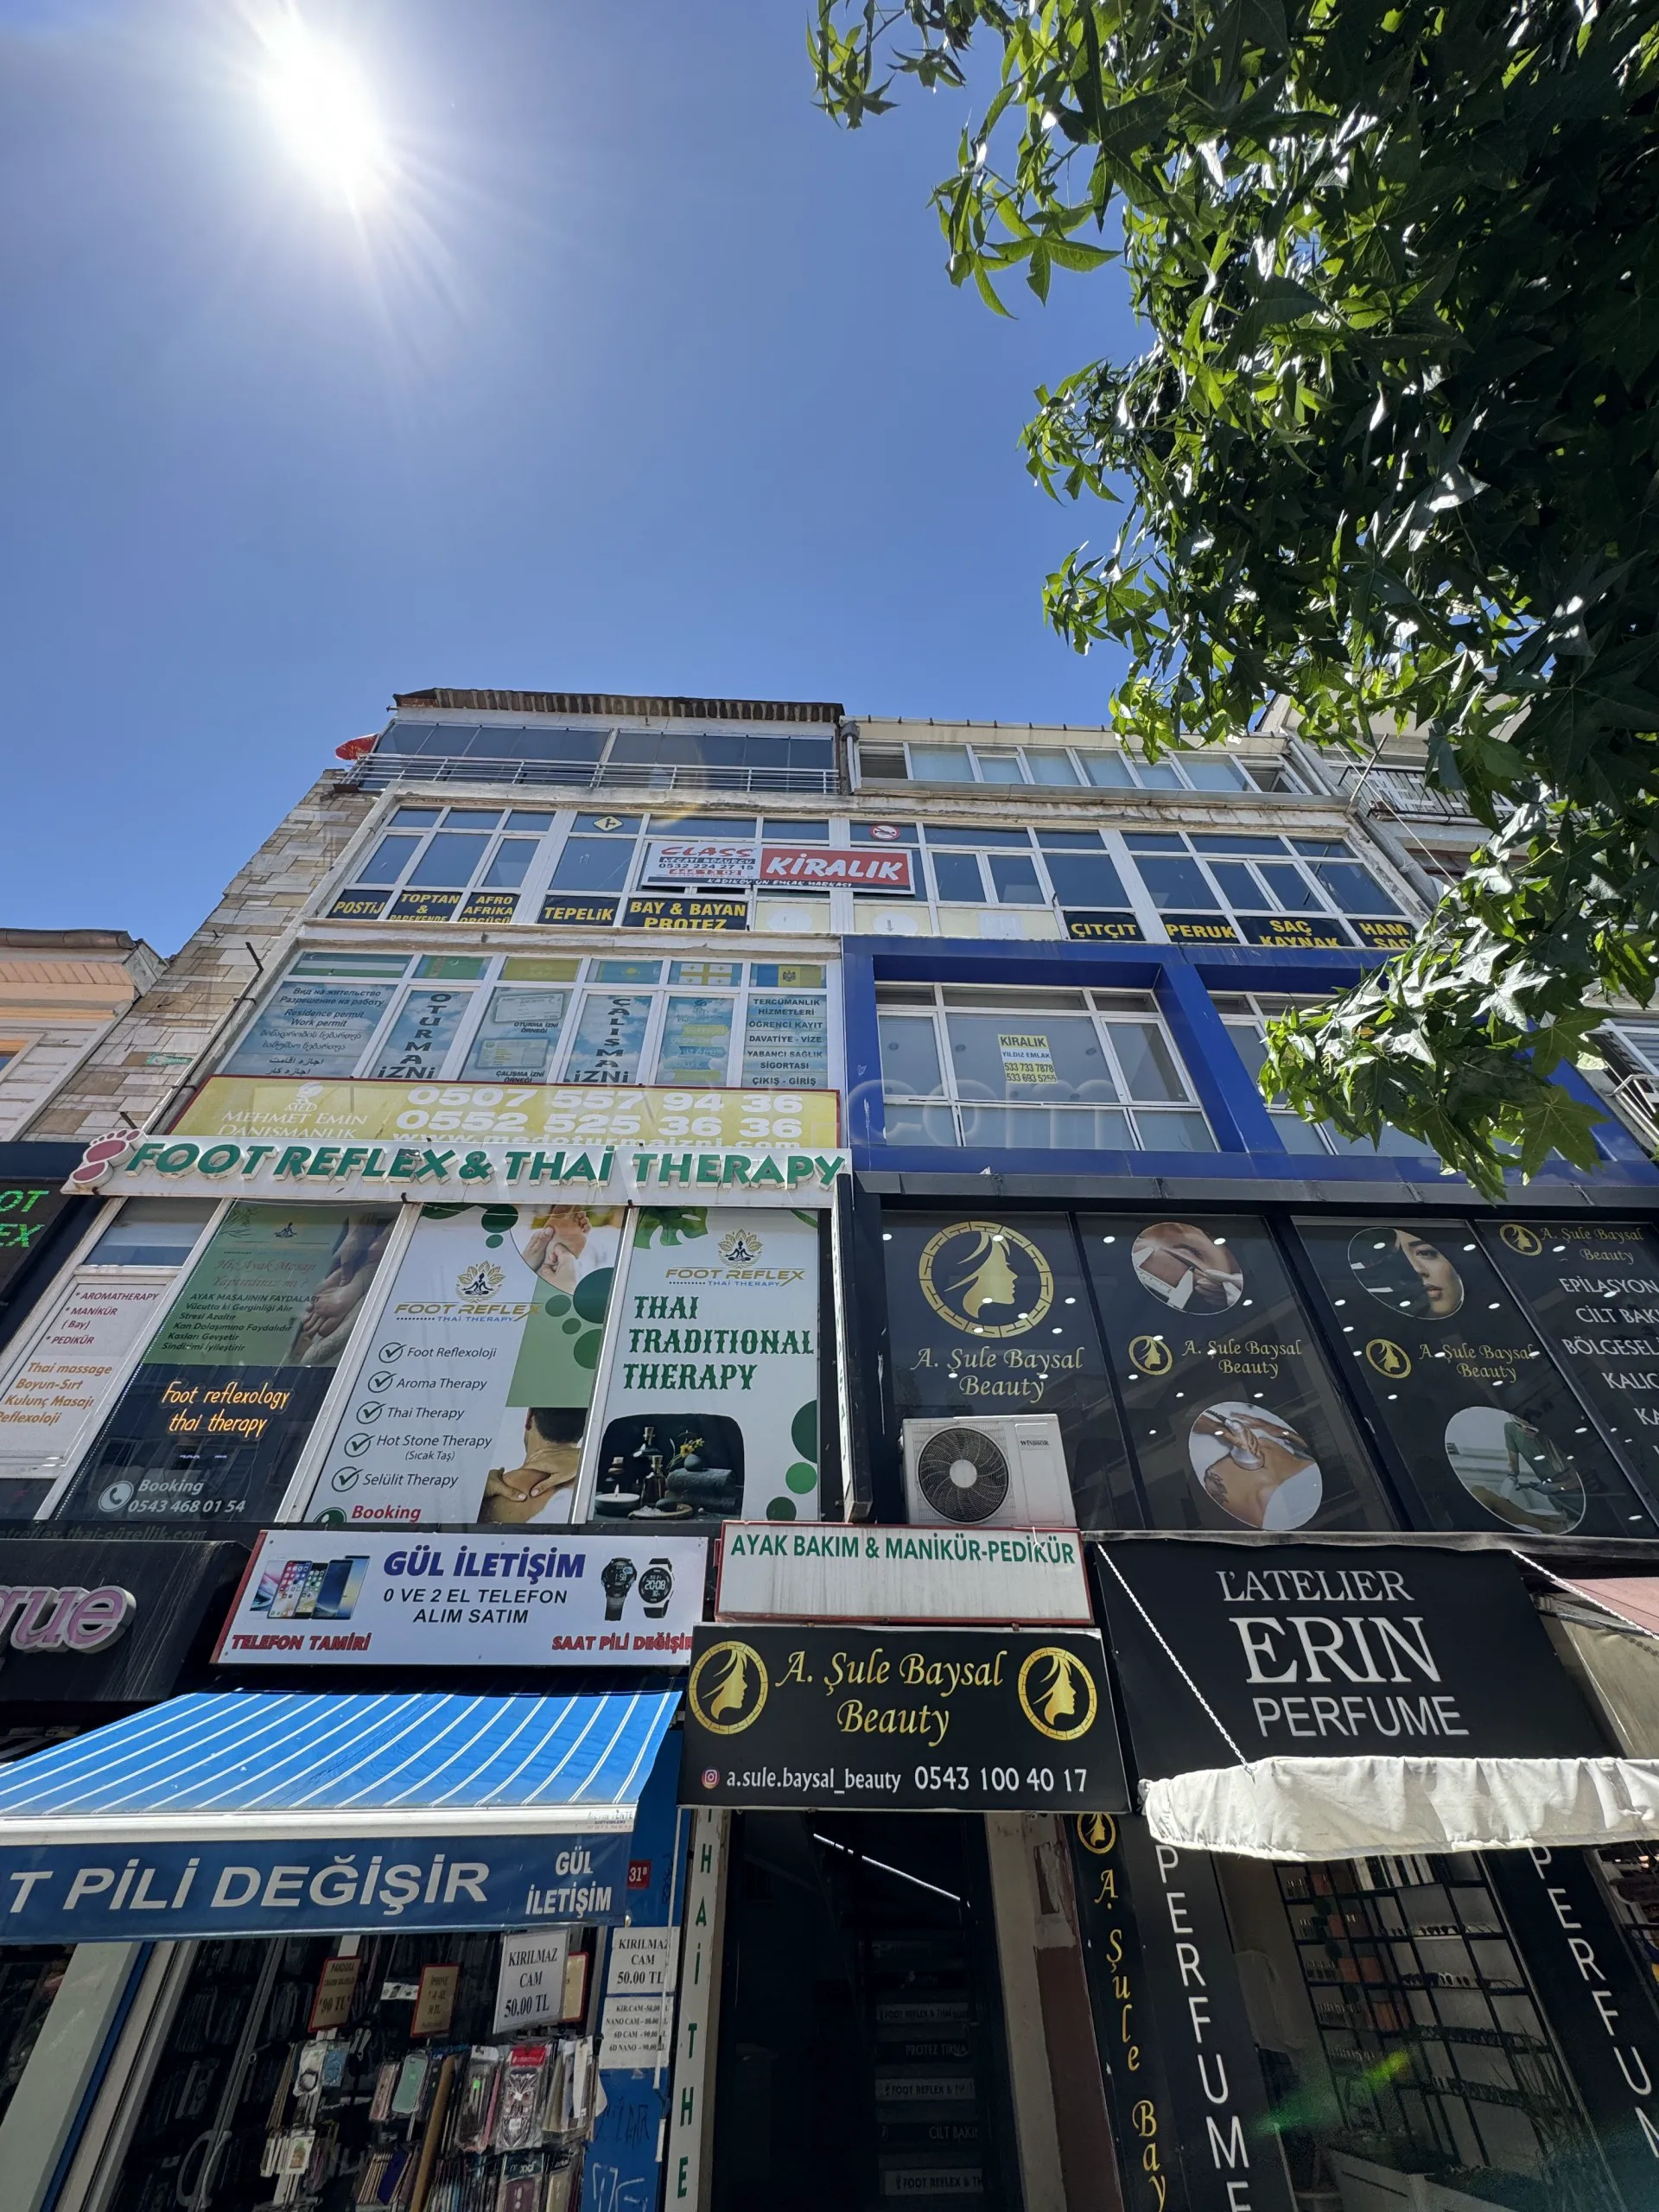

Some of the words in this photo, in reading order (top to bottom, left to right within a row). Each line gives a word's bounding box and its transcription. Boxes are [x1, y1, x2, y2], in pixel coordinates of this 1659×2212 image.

[766, 853, 903, 880] KİRALIK
[401, 893, 460, 904] TOPTAN
[476, 896, 512, 905] AFRO
[630, 901, 664, 914] BAY
[670, 903, 683, 915] &
[690, 904, 746, 917] BAYAN
[645, 917, 728, 930] PROTEZ
[1071, 923, 1136, 939] ÇITÇIT
[1166, 925, 1237, 938] PERUK
[1269, 919, 1313, 936] SAÇ
[1358, 922, 1408, 936] HAM
[1259, 935, 1340, 947] KAYNAK
[753, 997, 820, 1007] TERCÜMANLIK
[284, 1008, 332, 1017] Residence
[334, 1010, 365, 1020] permit
[758, 1007, 815, 1016] HİZMETLERİ
[315, 1020, 347, 1028] permit
[748, 1019, 792, 1029] ÖĞRENCİ
[749, 1033, 793, 1043] DAVATİYE
[800, 1034, 822, 1044] VİZE
[999, 1035, 1047, 1048] KİRALIK
[747, 1050, 787, 1058] YABANCI
[789, 1048, 823, 1058] SAĞLIK
[760, 1059, 810, 1070] SİGORTASI
[1004, 1062, 1019, 1072] 533
[1020, 1062, 1034, 1072] 733
[1036, 1063, 1054, 1073] 7878
[752, 1077, 779, 1087] ÇIKIŞ
[788, 1075, 817, 1087] GİRİŞ
[407, 1086, 537, 1108] 0507
[550, 1090, 644, 1109] 557
[663, 1092, 723, 1111] 94
[741, 1094, 803, 1113] 36
[220, 1110, 311, 1125] MEHMET
[315, 1112, 368, 1125] EMİN
[396, 1109, 529, 1131] 0552
[543, 1113, 641, 1135] 525
[658, 1116, 722, 1137] 36
[739, 1118, 803, 1138] 36
[459, 1150, 495, 1185] &
[632, 1153, 845, 1190] THERAPY
[1593, 1228, 1645, 1244] Baysal
[1580, 1249, 1634, 1264] Beauty
[665, 1268, 723, 1279] FOOT
[726, 1269, 805, 1287] REFLEX
[79, 1292, 159, 1300] AROMATHERAPY
[70, 1305, 118, 1315] MANİKÜR
[186, 1302, 220, 1311] Vücutta
[634, 1295, 699, 1319] THAI
[1575, 1305, 1618, 1324] CİLT
[629, 1328, 814, 1355] TRADITIONAL
[1561, 1336, 1659, 1355] BÖLGESEL
[407, 1347, 434, 1357] Foot
[435, 1347, 497, 1359] Reflexoloji
[27, 1362, 56, 1373] Thai
[57, 1364, 113, 1376] massage
[623, 1363, 758, 1390] THERAPY
[396, 1378, 436, 1389] Aroma
[440, 1378, 487, 1391] Therapy
[4, 1395, 49, 1408] Kulunç
[50, 1395, 94, 1409] Masajı
[204, 1382, 290, 1409] reflexology
[168, 1408, 203, 1432] thai
[208, 1408, 268, 1438] therapy
[377, 1435, 402, 1446] Hot
[404, 1435, 439, 1446] Stone
[442, 1436, 492, 1449] Therapy
[137, 1478, 204, 1496] Booking
[363, 1473, 404, 1485] Selülit
[407, 1474, 458, 1489] Therapy
[129, 1499, 167, 1512] 0543
[172, 1500, 200, 1512] 468
[202, 1500, 221, 1512] 01
[226, 1500, 246, 1512] 54
[351, 1505, 422, 1522] Booking
[731, 1535, 788, 1556] AYAK
[793, 1535, 861, 1558] BAKIM
[865, 1537, 880, 1559] &
[886, 1532, 1076, 1564] MANİKÜR-PEDİKÜR
[383, 1546, 445, 1579] GÜL
[454, 1545, 586, 1585] İLETİŞİM
[1215, 1570, 1414, 1601] L'ATELIER
[401, 1588, 426, 1603] VE
[447, 1589, 471, 1603] EL
[478, 1588, 568, 1605] TELEFON
[413, 1608, 463, 1624] ALIM
[468, 1608, 529, 1624] SATIM
[231, 1634, 303, 1650] TELEFON
[308, 1631, 373, 1651] TAMİRİ
[551, 1635, 595, 1650] SAAT
[599, 1632, 630, 1650] PİLİ
[1229, 1617, 1442, 1683] ERIN
[775, 1650, 813, 1688] A.
[824, 1648, 891, 1695] Şule
[899, 1649, 1008, 1698] Baysal
[836, 1699, 950, 1747] Beauty
[1253, 1696, 1470, 1738] PERFUME
[727, 1766, 901, 1795] a.sule.baysal_beauty
[915, 1766, 969, 1791] 0543
[981, 1767, 1020, 1791] 100
[1027, 1767, 1055, 1792] 40
[1065, 1768, 1087, 1793] 17
[555, 1846, 594, 1876] GÜL
[63, 1857, 200, 1911] PİLİ
[212, 1854, 489, 1916] DEĞİŞİR
[525, 1882, 613, 1919] İLETİŞİM
[508, 1948, 558, 1967] KIRILMAZ
[519, 1971, 543, 1988] CAM
[505, 1995, 534, 2018] 50.00
[536, 1994, 550, 2012] TL
